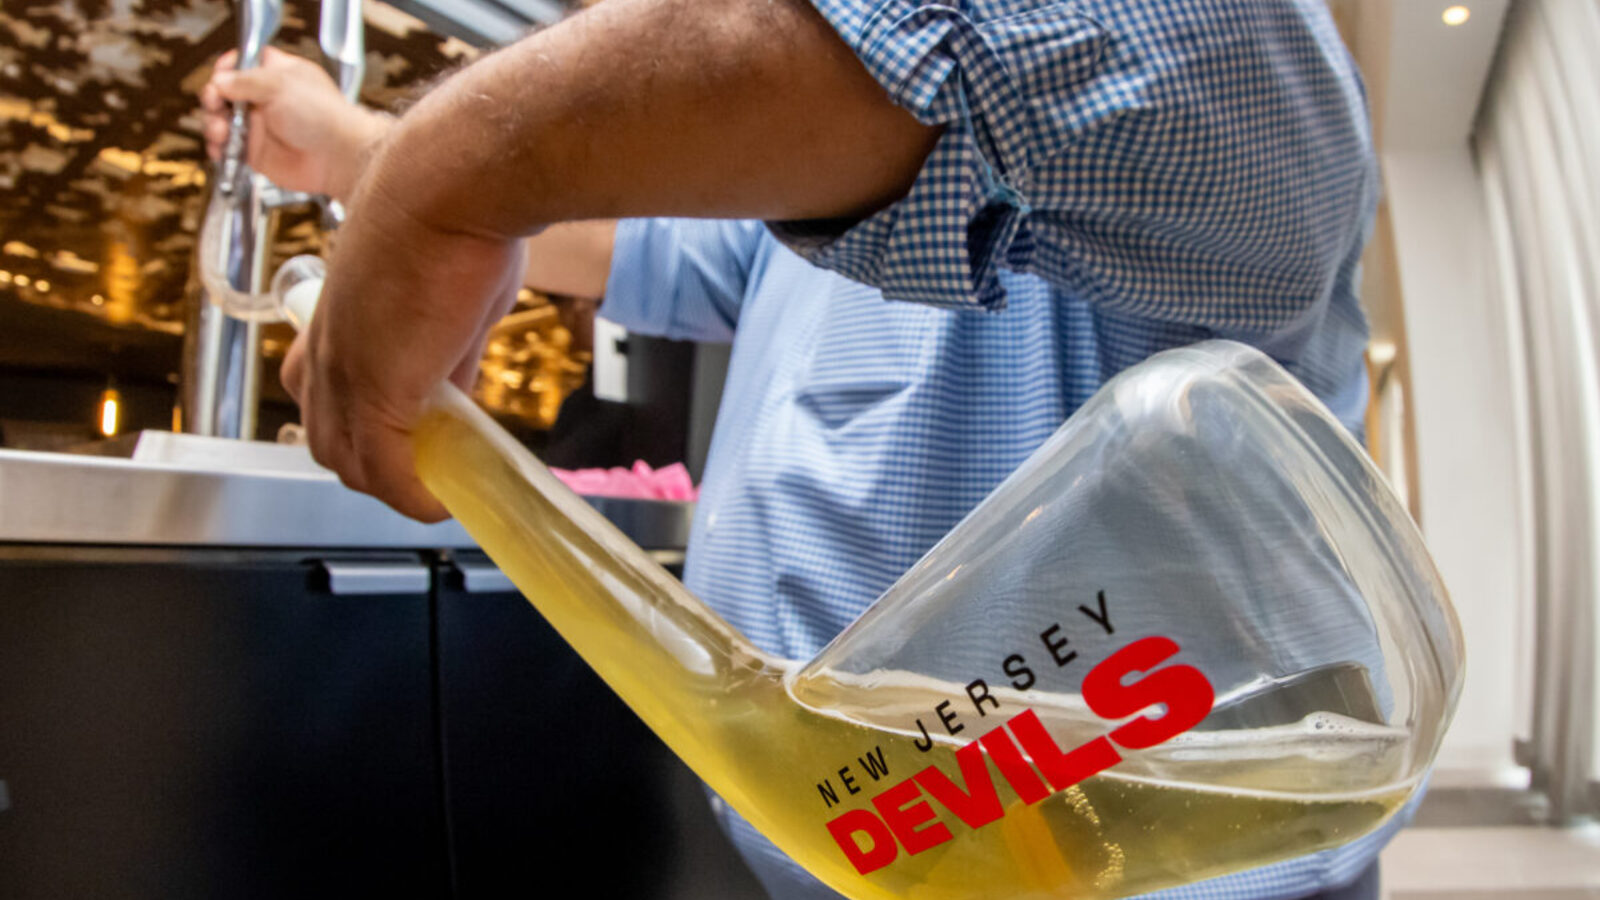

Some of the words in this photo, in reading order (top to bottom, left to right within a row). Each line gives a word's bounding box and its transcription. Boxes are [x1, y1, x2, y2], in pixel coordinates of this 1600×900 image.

[816, 746, 889, 808] NEW
[913, 591, 1115, 753] JERSEY
[825, 636, 1215, 876] DEVILS
